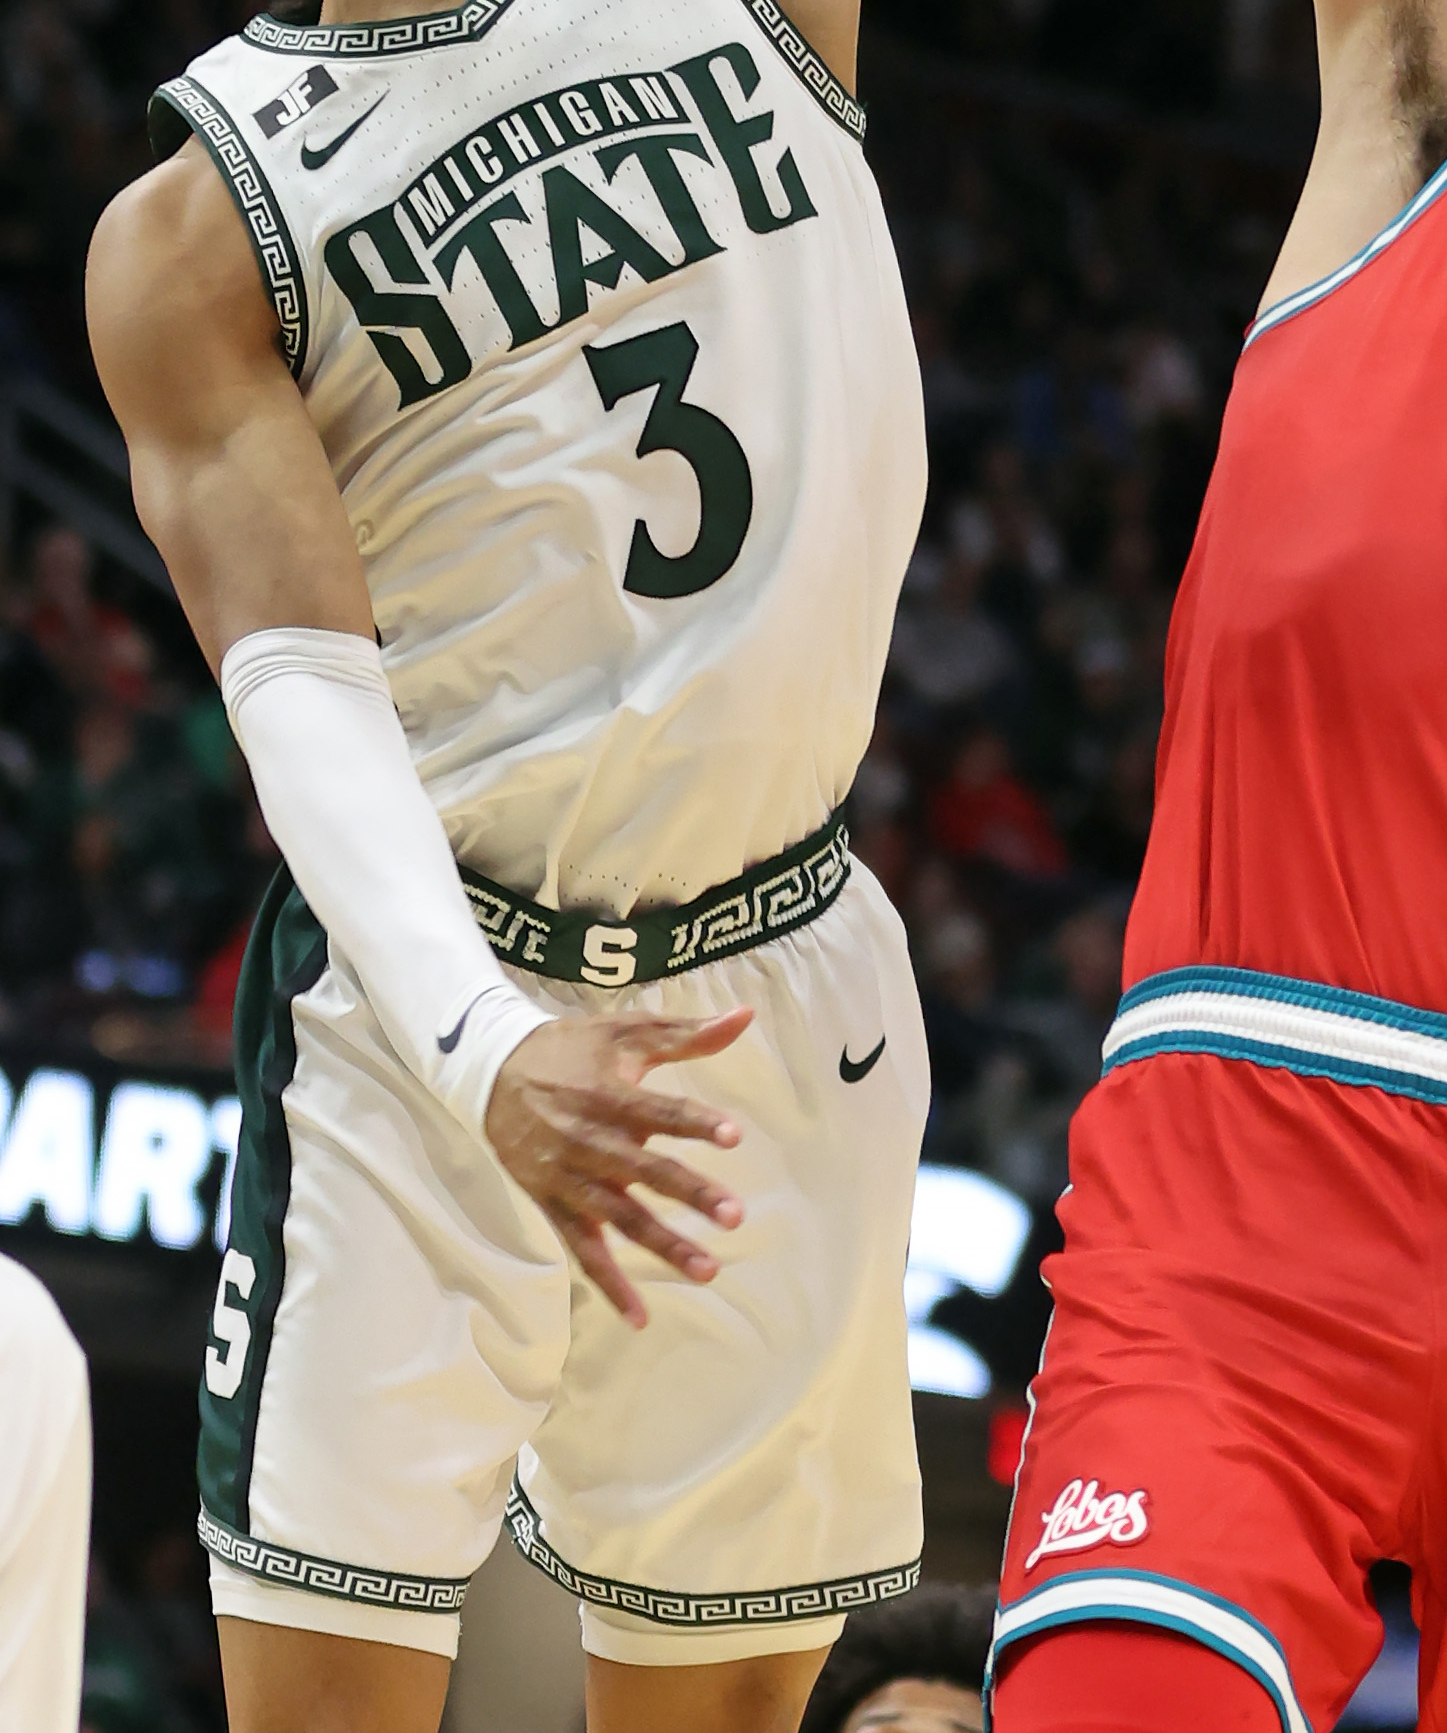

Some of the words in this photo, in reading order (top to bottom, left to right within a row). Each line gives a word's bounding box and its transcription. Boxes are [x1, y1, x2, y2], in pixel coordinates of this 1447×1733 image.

[275, 71, 313, 127] JF
[409, 72, 674, 234] MICHIGAN
[324, 42, 819, 411] STATE
[581, 321, 753, 599] 3
[580, 924, 638, 987] S
[204, 1248, 257, 1400] S
[1025, 1478, 1147, 1570] Lobos
